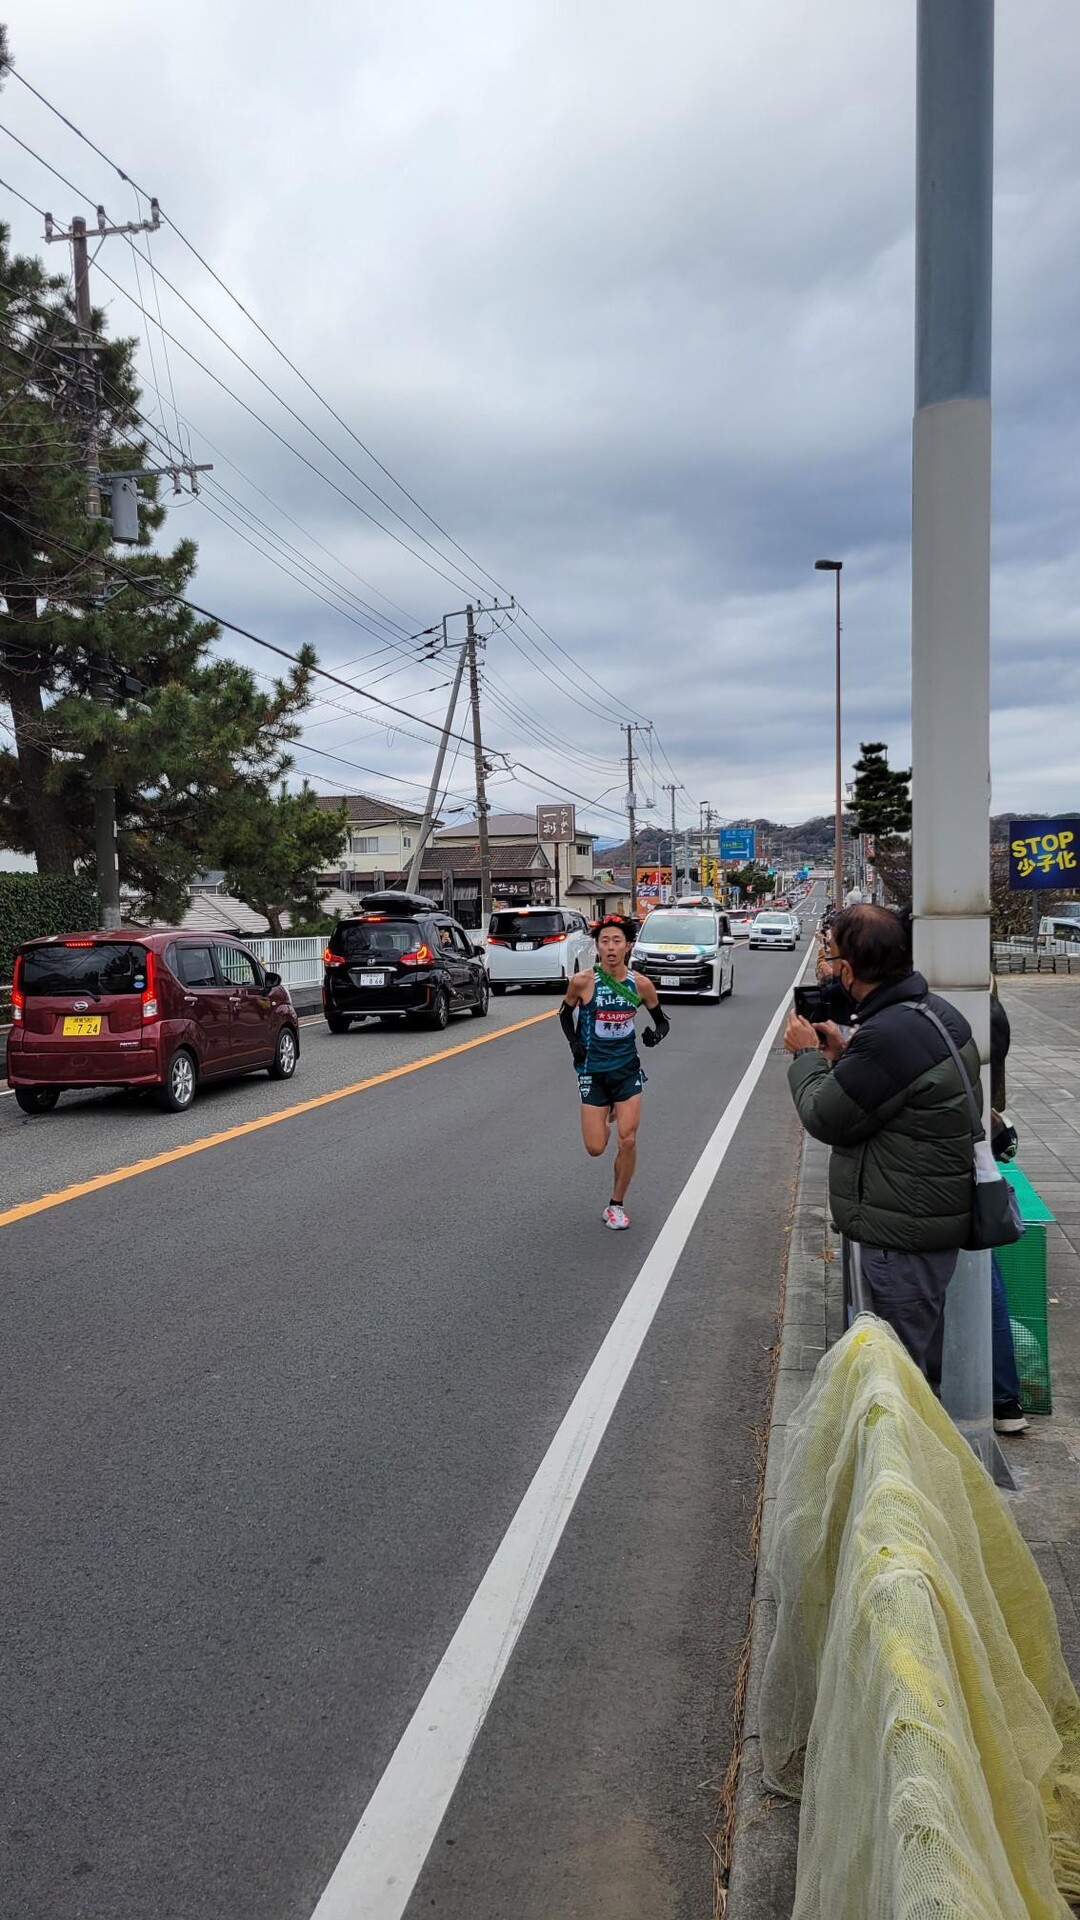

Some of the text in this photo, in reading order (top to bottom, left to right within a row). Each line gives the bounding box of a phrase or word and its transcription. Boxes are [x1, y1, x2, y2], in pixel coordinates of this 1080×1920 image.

[1011, 831, 1074, 858] STOP
[1016, 850, 1077, 877] 少子化
